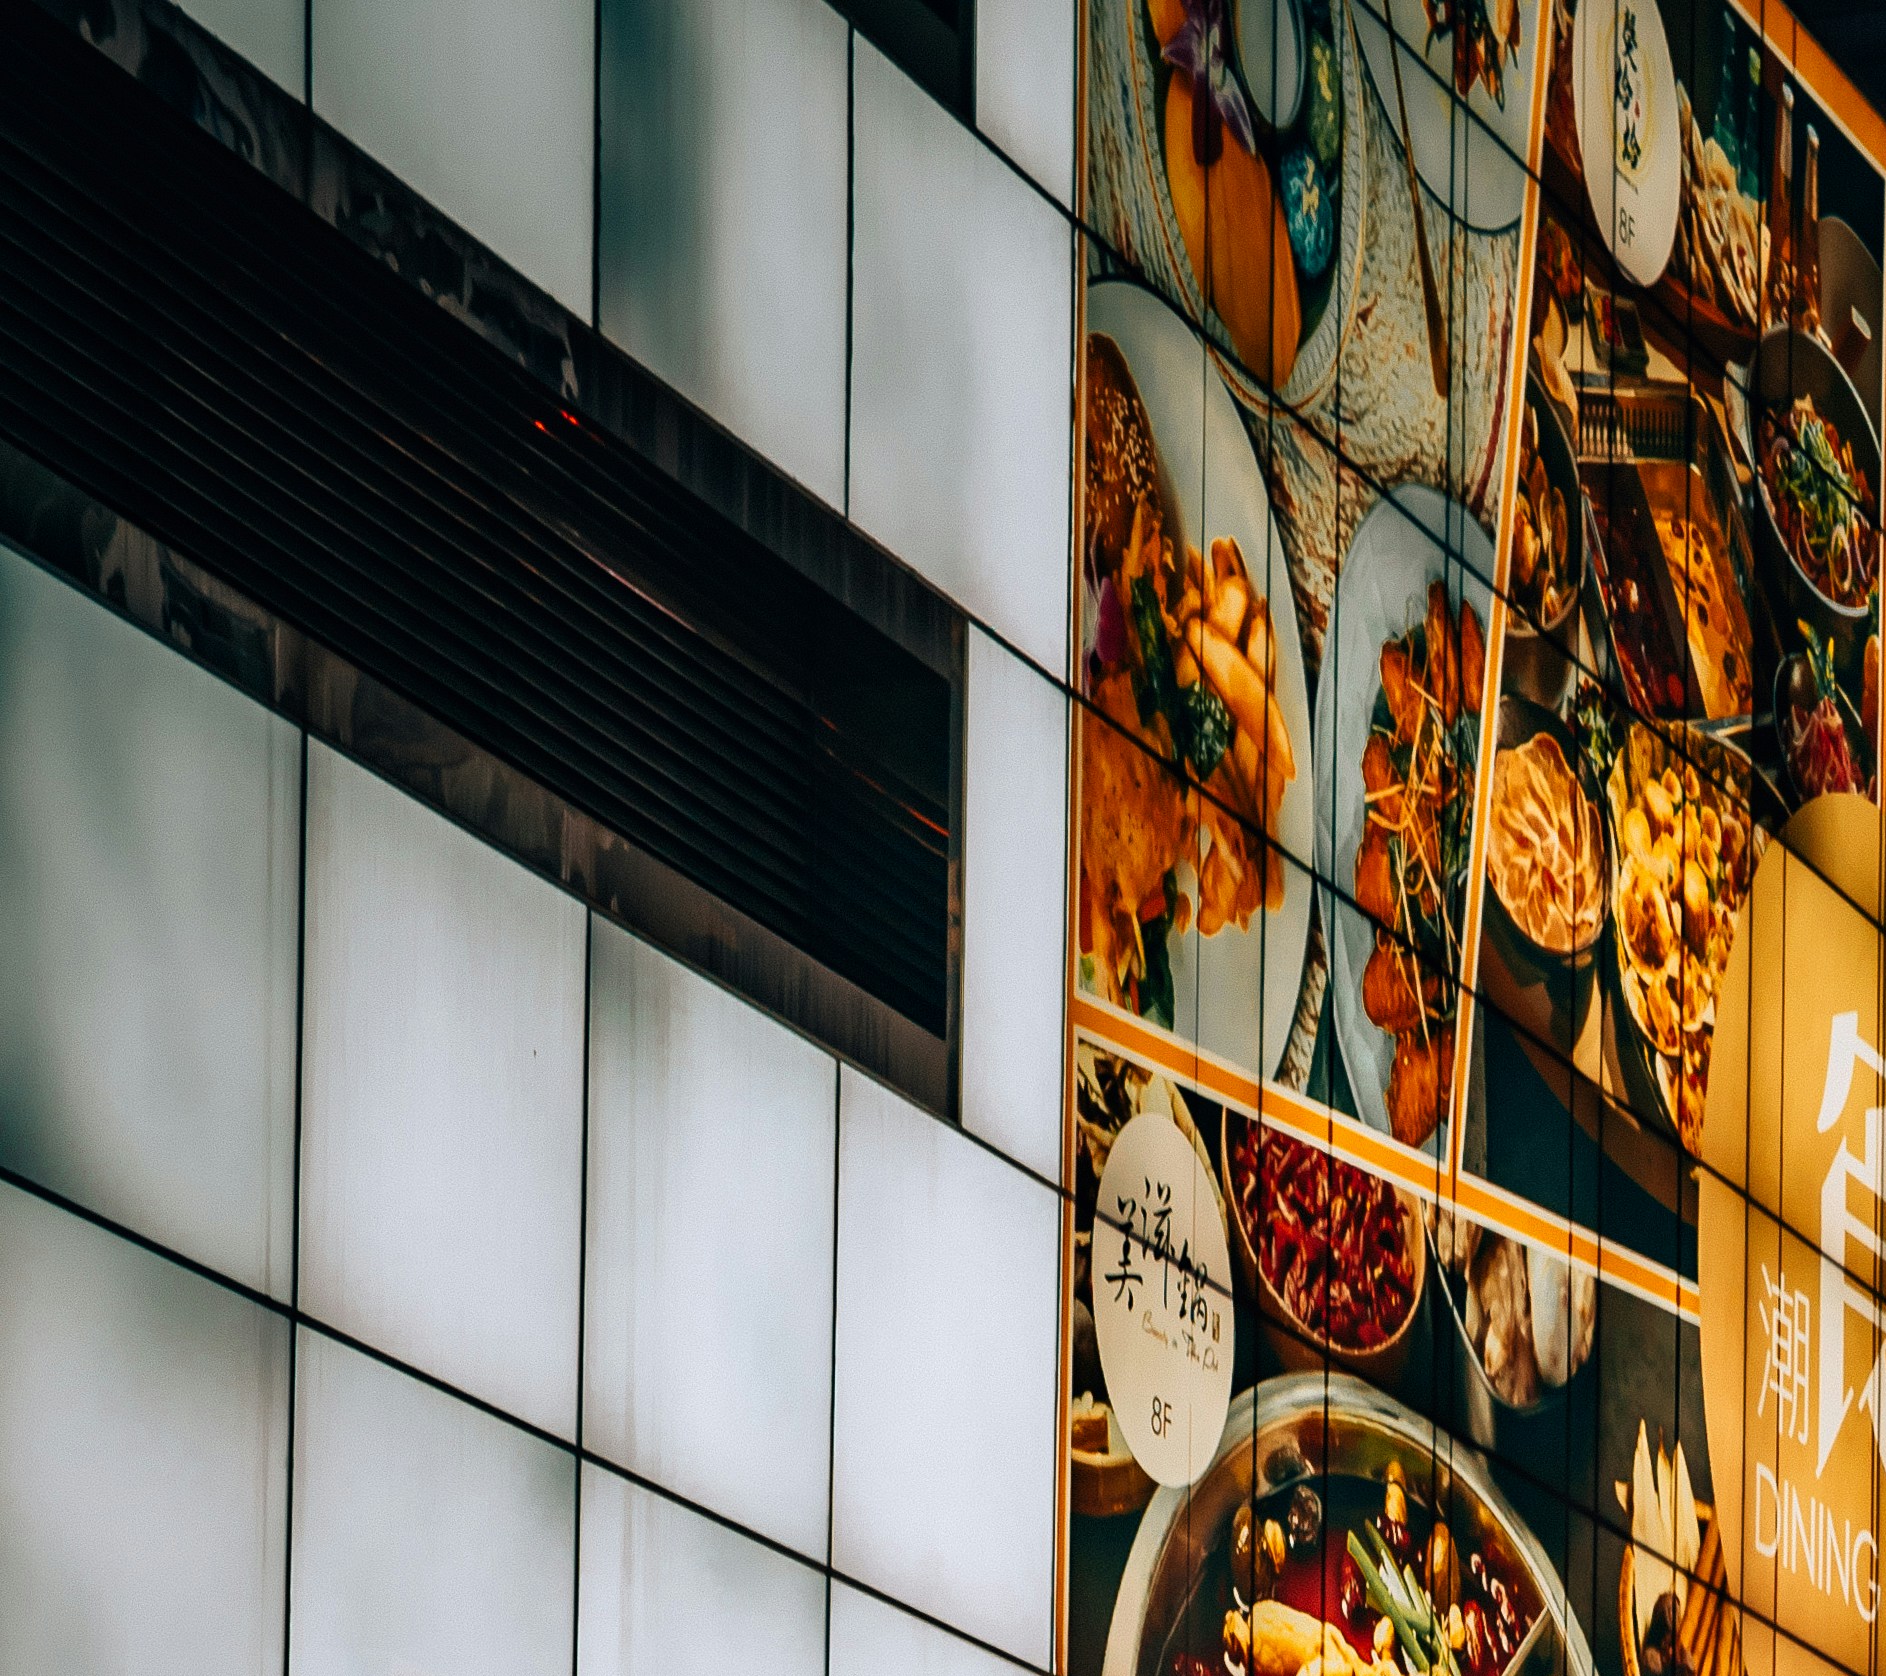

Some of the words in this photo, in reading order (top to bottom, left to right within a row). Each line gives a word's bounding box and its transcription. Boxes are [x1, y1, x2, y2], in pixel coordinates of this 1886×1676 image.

[1617, 206, 1636, 248] 8F
[1756, 1262, 1811, 1446] 潮
[1150, 1395, 1173, 1440] 8F
[1754, 1461, 1882, 1623] DINING
